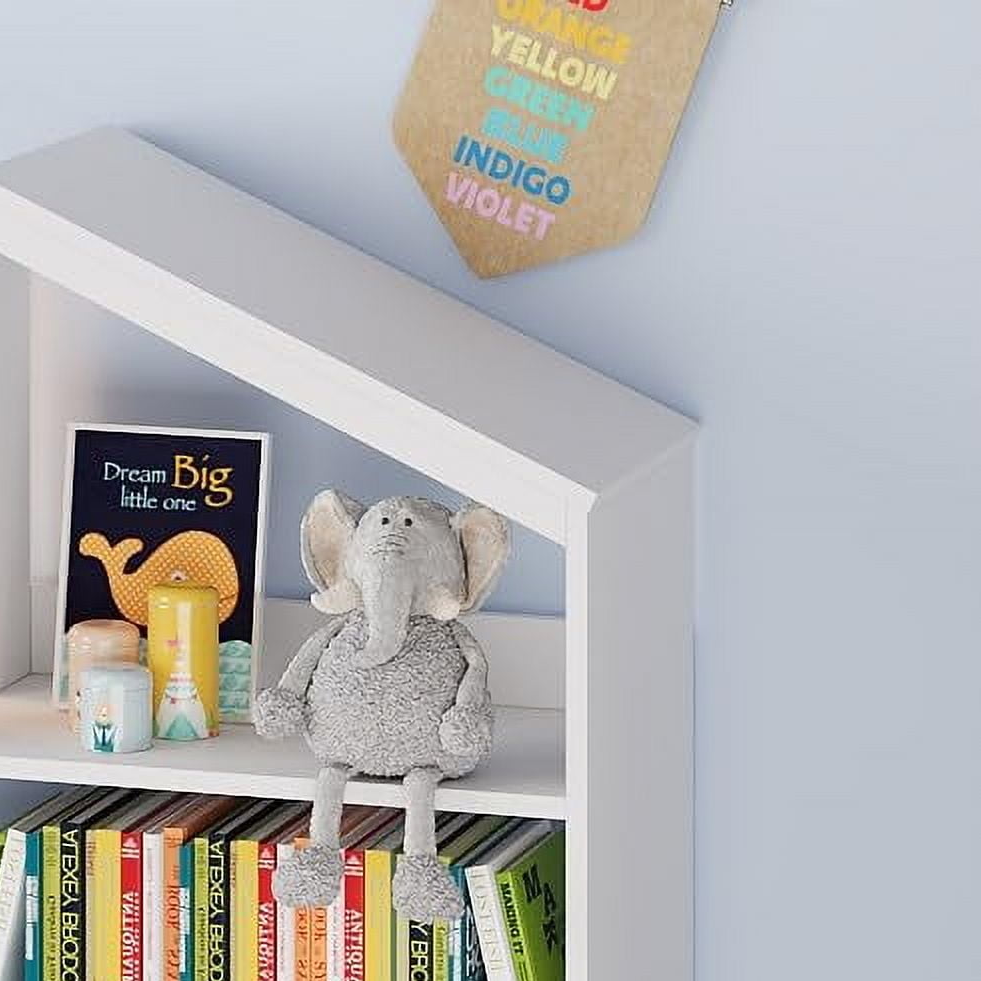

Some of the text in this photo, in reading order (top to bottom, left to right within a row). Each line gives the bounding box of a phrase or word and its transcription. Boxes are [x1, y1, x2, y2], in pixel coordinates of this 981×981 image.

[490, 25, 619, 100] YELLOW
[496, 0, 632, 64] ORANGE
[484, 66, 596, 131] GREEN
[481, 106, 572, 166] BLUE
[451, 134, 572, 206] INDIGO
[444, 171, 557, 241] VIOLET
[103, 455, 234, 508] Dream Big
[120, 485, 197, 512] little one
